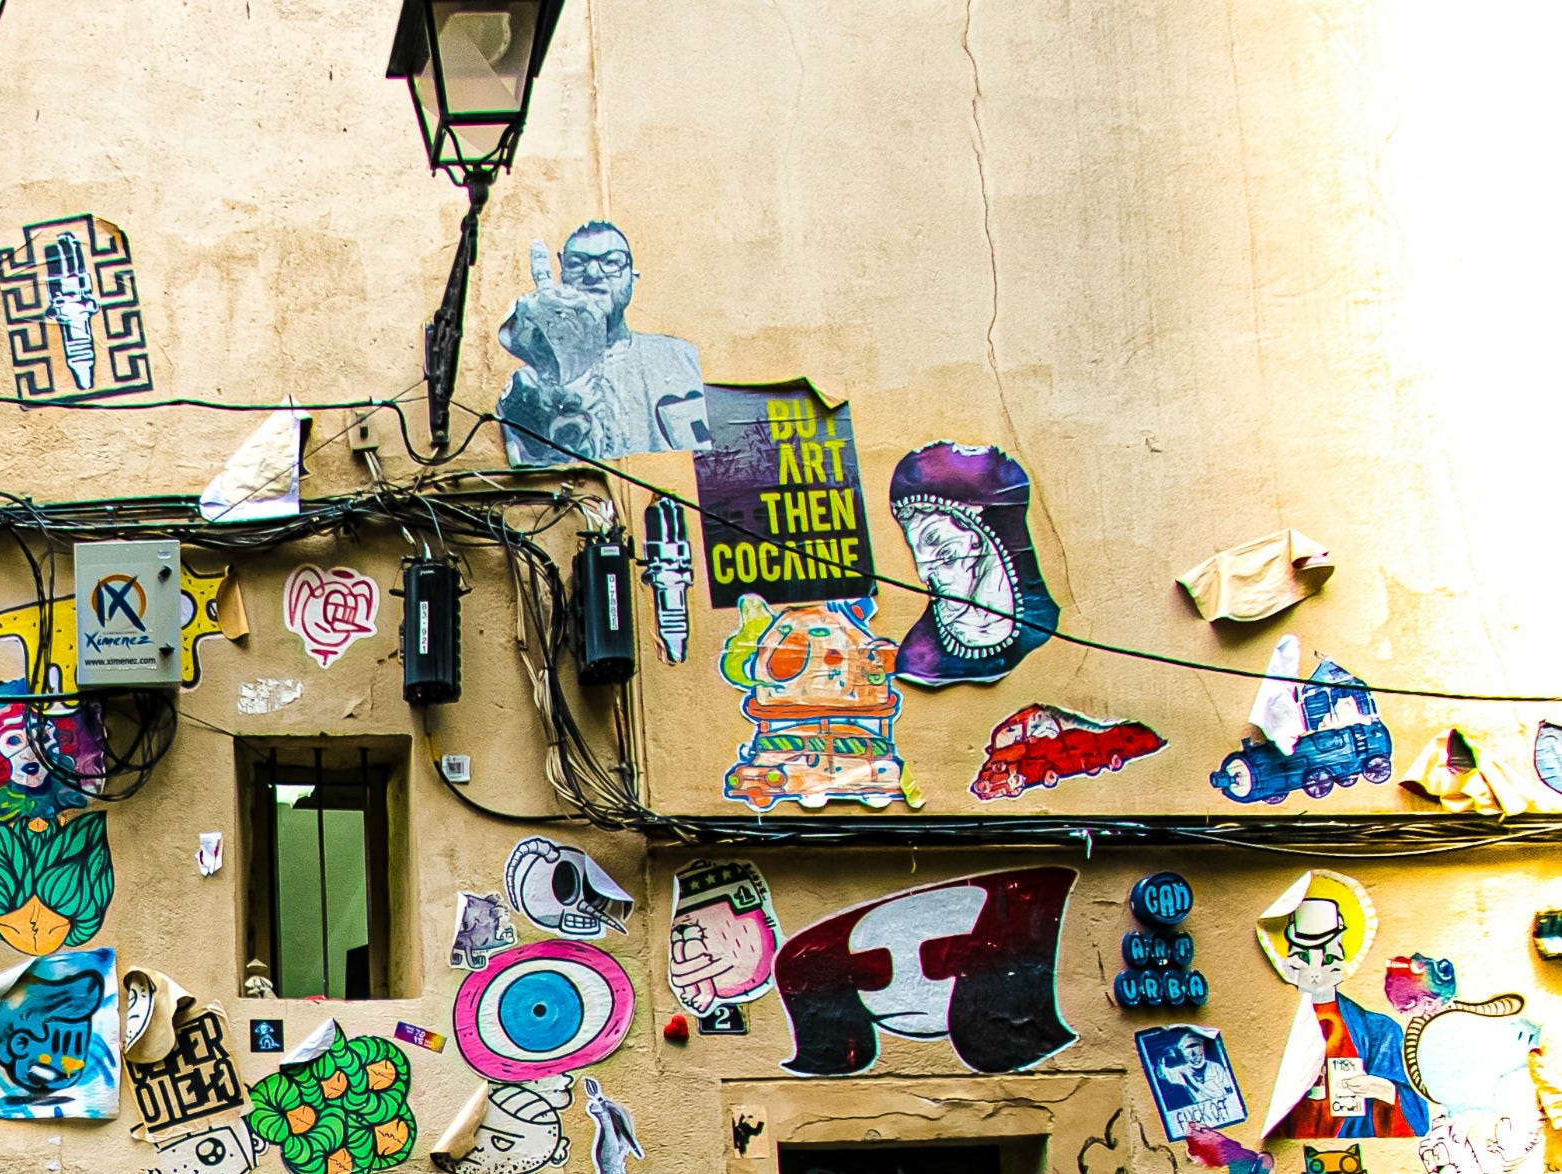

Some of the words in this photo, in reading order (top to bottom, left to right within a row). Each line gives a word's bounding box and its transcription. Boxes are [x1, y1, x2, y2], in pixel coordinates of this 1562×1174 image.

[779, 440, 845, 485] ART
[760, 489, 856, 534] THEN
[712, 538, 863, 584] COCAINE
[84, 656, 157, 667] www.ximenez.com
[1123, 975, 1204, 999] URBA
[714, 1006, 731, 1030] 2
